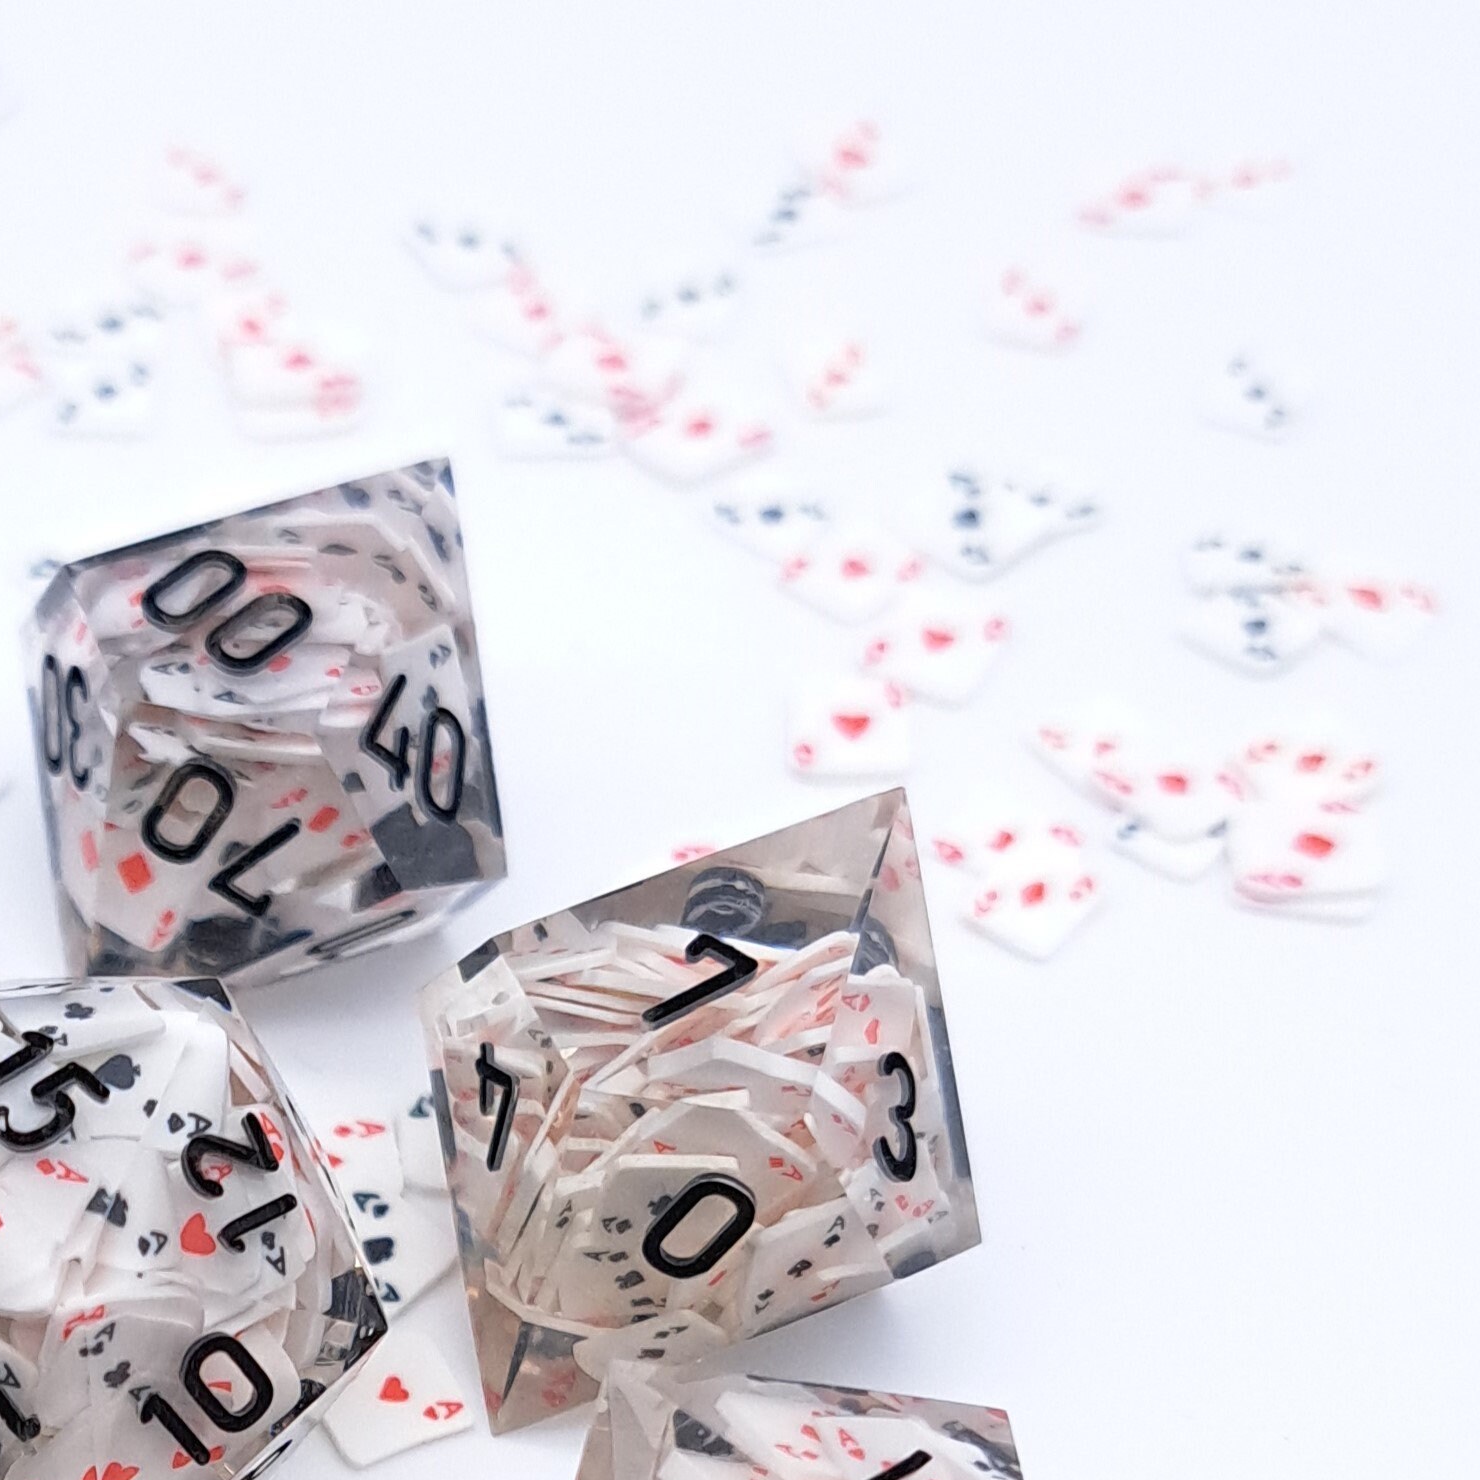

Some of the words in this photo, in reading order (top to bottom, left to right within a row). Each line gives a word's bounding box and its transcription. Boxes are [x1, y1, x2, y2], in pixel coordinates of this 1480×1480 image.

[141, 550, 312, 676] 00
[41, 653, 89, 791] 30
[360, 673, 467, 822] 40
[141, 756, 300, 917] 70
[474, 1042, 518, 1172] 4
[873, 1051, 918, 1183] 3
[187, 1113, 212, 1138] A
[356, 1121, 385, 1137] A
[56, 1160, 89, 1184] A
[182, 1112, 297, 1253] 12
[352, 1192, 380, 1213] A
[642, 1173, 757, 1279] 0
[827, 1215, 845, 1233] A
[150, 1231, 168, 1256] A
[266, 1247, 286, 1276] A
[94, 1322, 116, 1342] A
[0, 1363, 21, 1388] A
[140, 1331, 274, 1466] 10
[436, 1401, 464, 1420] A
[838, 1428, 858, 1447] A
